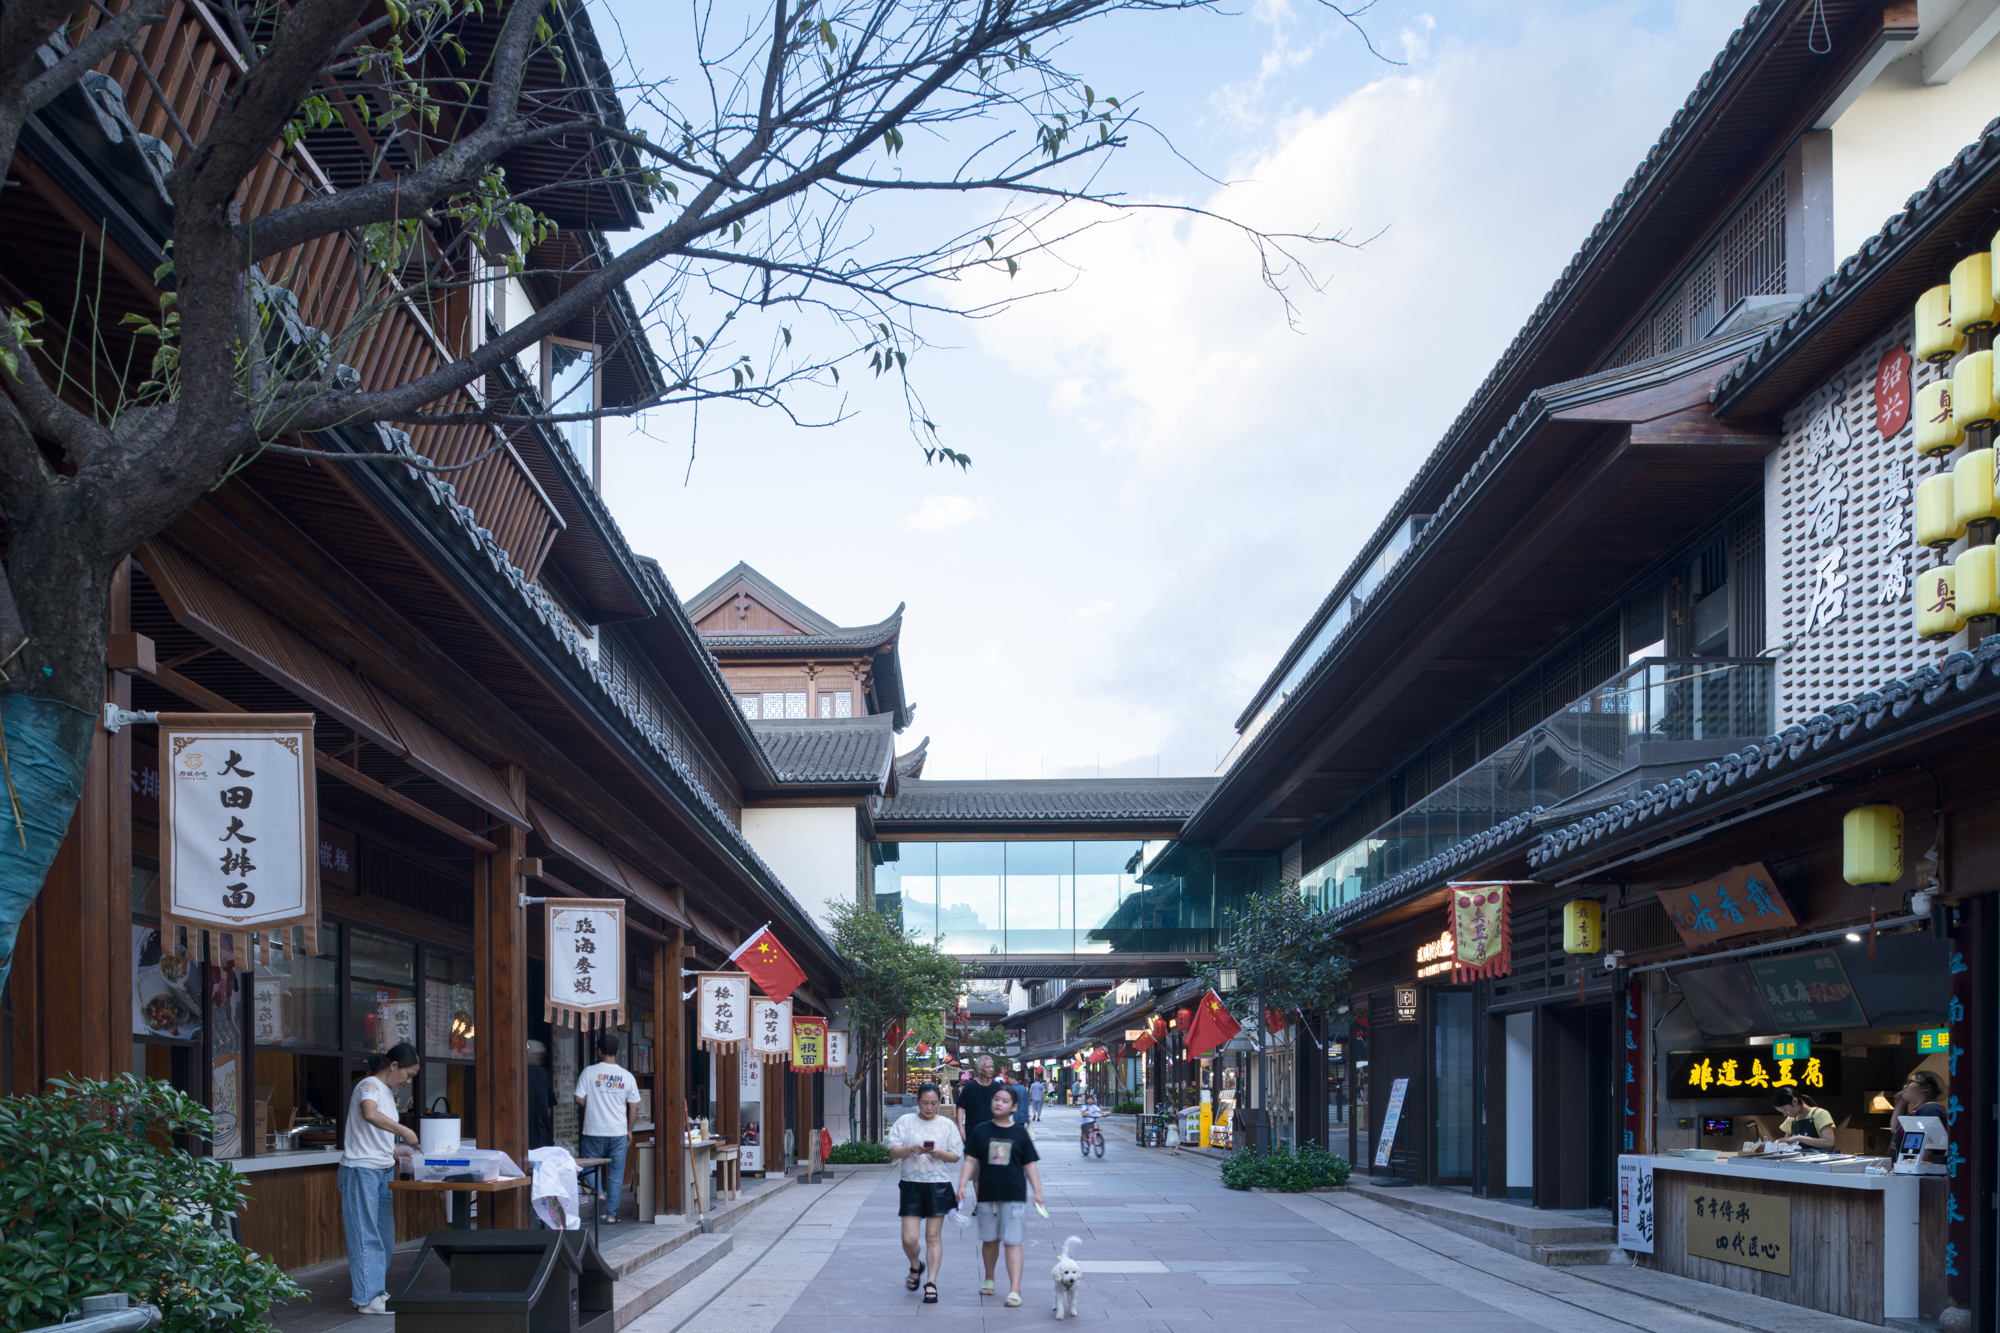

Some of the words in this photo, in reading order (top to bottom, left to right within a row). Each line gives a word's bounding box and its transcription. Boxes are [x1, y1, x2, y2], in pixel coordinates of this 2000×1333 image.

[1881, 355, 1904, 428] 绍兴
[1805, 379, 1851, 634] 戴香居
[1878, 460, 1911, 605] 臭豆腐
[1926, 577, 1955, 613] 臭
[217, 749, 257, 910] 大田大排面
[319, 841, 349, 875] 嵌糕
[1689, 875, 1781, 933] 戴香居
[1471, 906, 1488, 960] 臭豆腐
[1575, 907, 1591, 948] 戴香居
[573, 916, 597, 996] 臨海麥蝦
[714, 986, 734, 1035] 梅花糕
[1766, 979, 1811, 1006] 臭豆腐
[1776, 1012, 1788, 1023] 15
[1796, 1010, 1807, 1022] 10
[800, 1036, 817, 1065] 一根面
[1920, 1032, 1949, 1049] 点单
[595, 1080, 625, 1090] STORM
[597, 1073, 623, 1083] BRAIN
[1636, 1167, 1653, 1244] 招聘
[1716, 1230, 1780, 1260] 四代匠心
